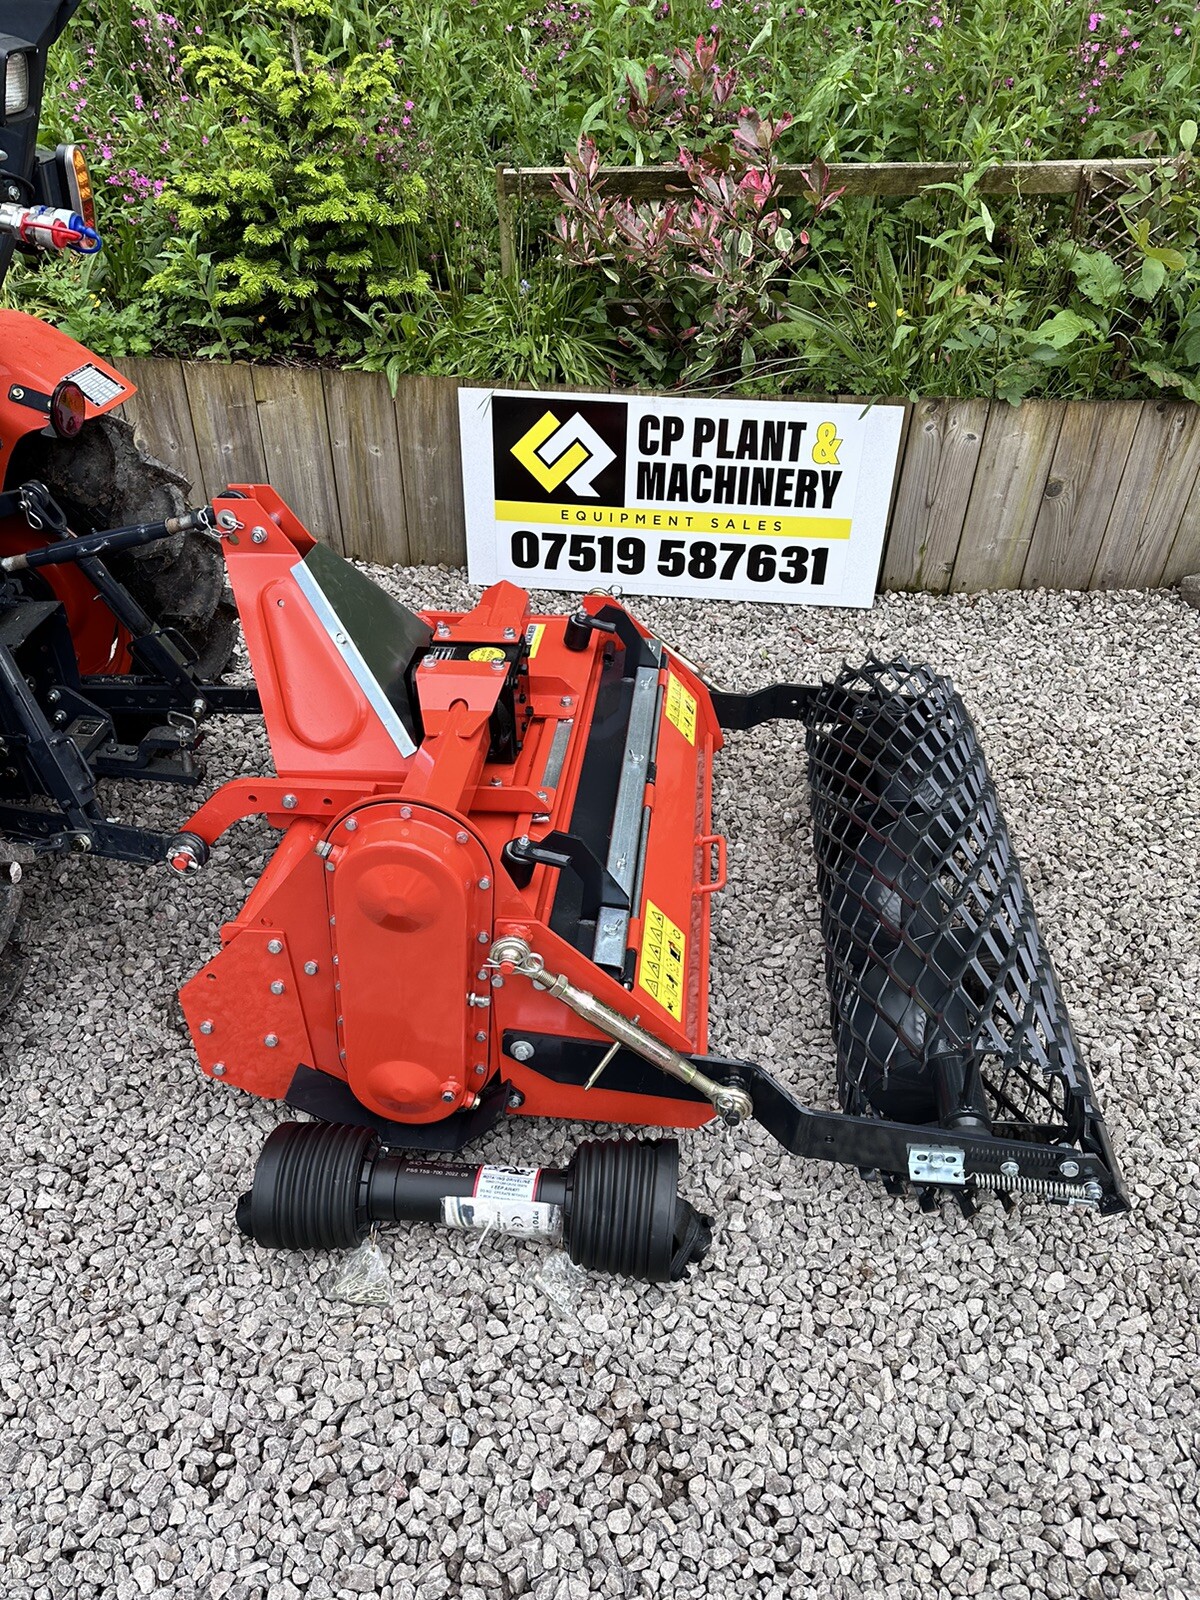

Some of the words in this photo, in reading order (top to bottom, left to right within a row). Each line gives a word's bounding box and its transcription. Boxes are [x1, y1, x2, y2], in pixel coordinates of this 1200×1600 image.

[638, 414, 684, 456] CP
[692, 417, 807, 462] PLANT
[811, 421, 843, 464] &
[636, 461, 843, 509] MACHINERY
[560, 509, 694, 527] EQUIPMENT
[710, 518, 782, 531] SALES
[511, 530, 645, 575] 07519
[657, 540, 829, 585] 587631
